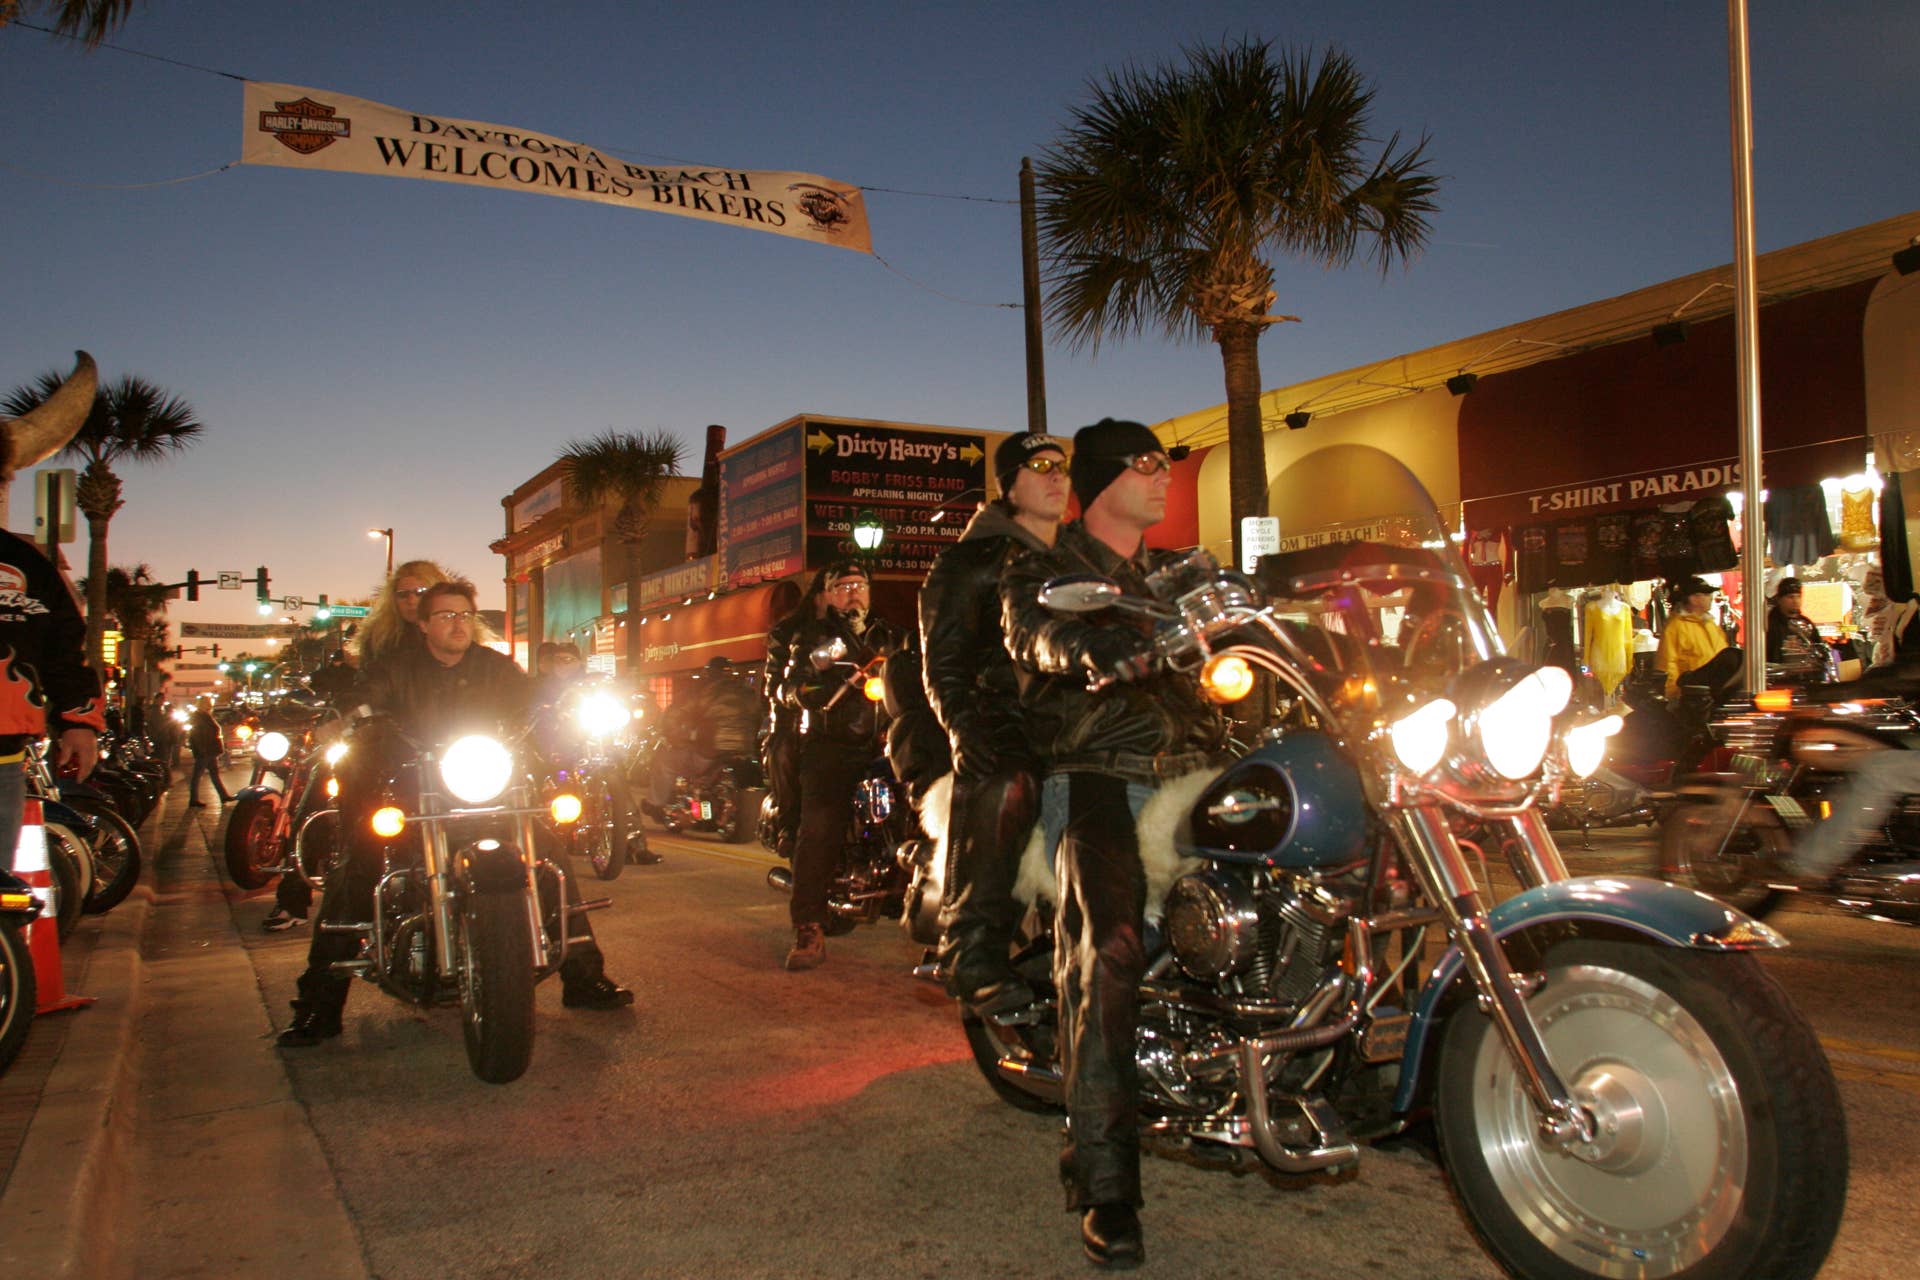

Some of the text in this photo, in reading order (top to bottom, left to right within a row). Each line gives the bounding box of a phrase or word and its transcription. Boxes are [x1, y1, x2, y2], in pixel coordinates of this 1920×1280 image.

[264, 115, 345, 132] HARLEY-DAVIDSON
[410, 115, 752, 191] DAYTONA BEACH
[374, 136, 786, 226] WELCOMES BIKERS
[836, 432, 957, 464] Dirty Harry's
[831, 470, 966, 491] BOBBY FRISS BAND
[1529, 460, 1767, 514] T-SHIRT PARADIS
[852, 487, 944, 502] APPEARING NIGHTLY
[814, 504, 847, 518] WET
[828, 521, 851, 532] 2:00
[896, 525, 918, 535] 7:00
[920, 526, 938, 536] P.M.
[1303, 534, 1324, 548] THE
[1329, 527, 1372, 544] BEACH
[881, 559, 894, 569] TO
[895, 559, 918, 569] 4:30
